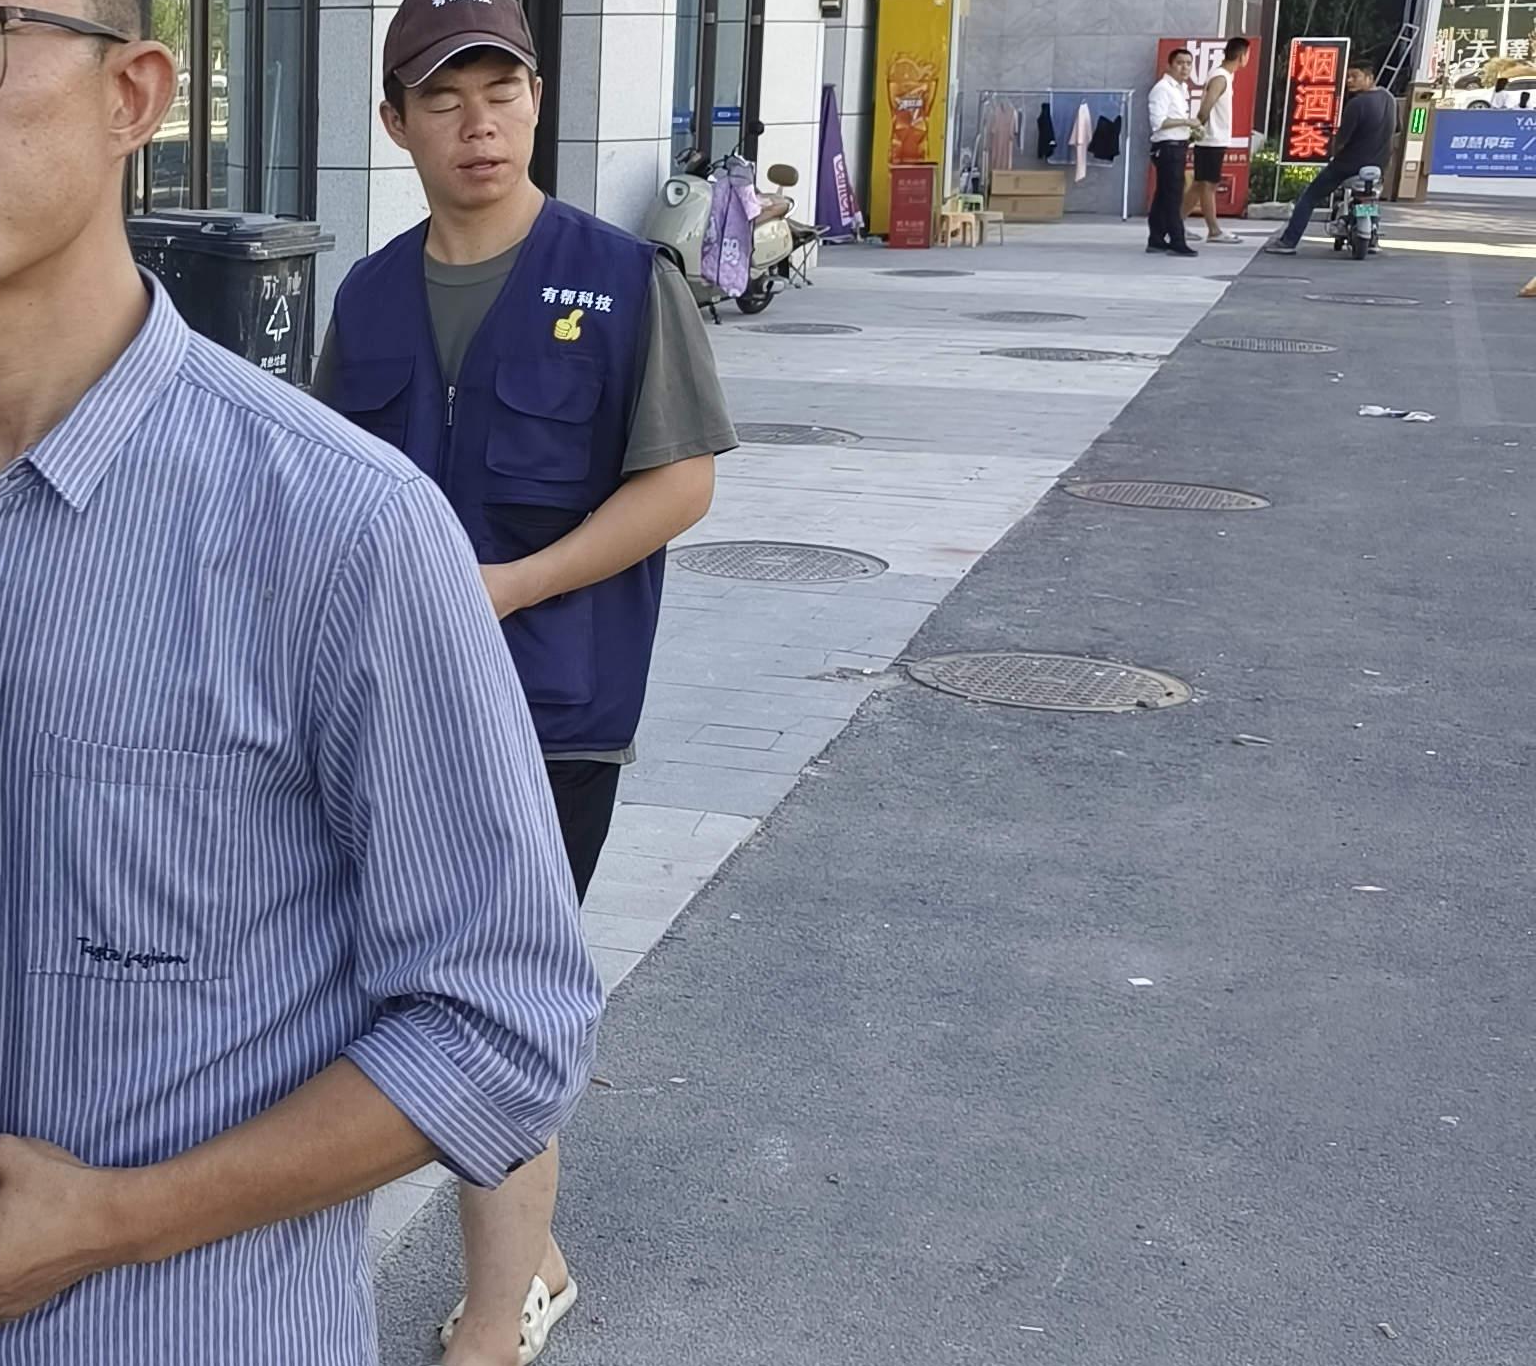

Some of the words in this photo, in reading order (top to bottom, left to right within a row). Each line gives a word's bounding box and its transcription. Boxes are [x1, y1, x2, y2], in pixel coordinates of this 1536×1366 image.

[1288, 45, 1340, 158] 烟酒茶
[541, 286, 613, 313] 有帮科技
